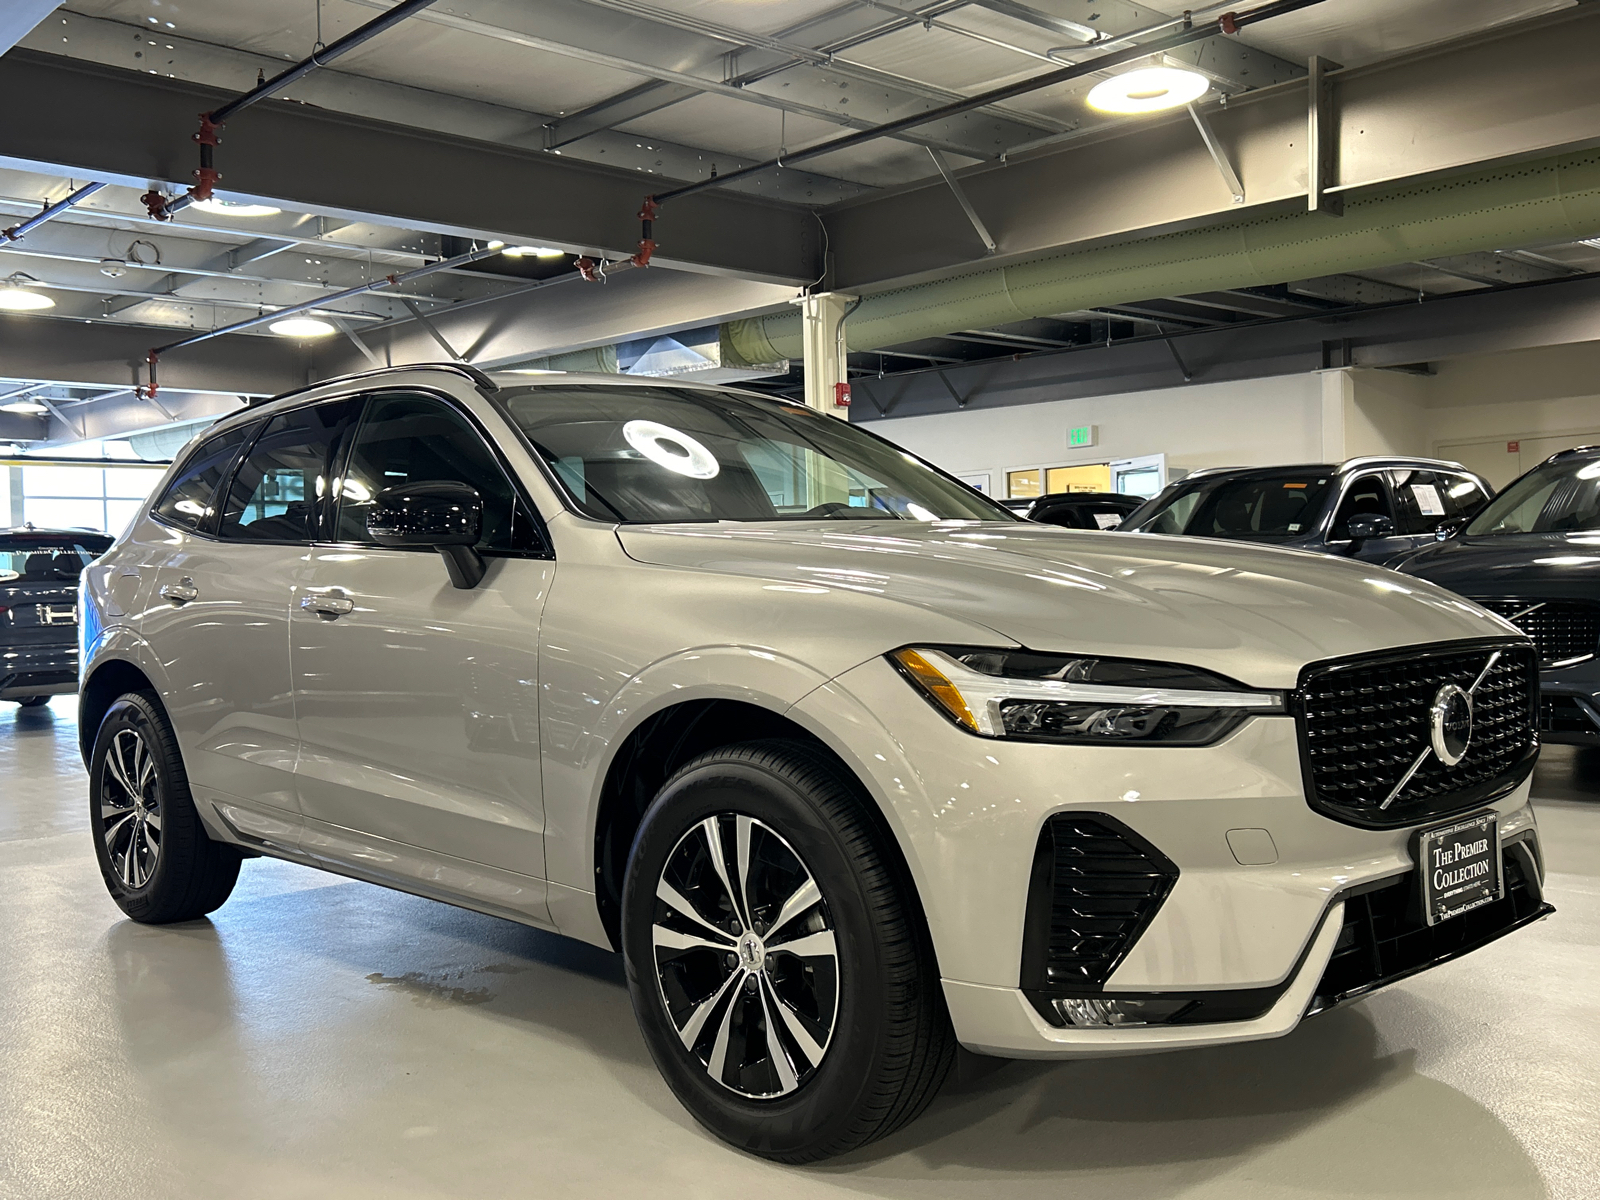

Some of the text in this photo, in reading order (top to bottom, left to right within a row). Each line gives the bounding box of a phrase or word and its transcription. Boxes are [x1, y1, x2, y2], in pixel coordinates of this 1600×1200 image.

[1070, 427, 1088, 445] EXIT
[1433, 839, 1488, 868] THE PREMIER
[1433, 859, 1489, 890] COLLECTION
